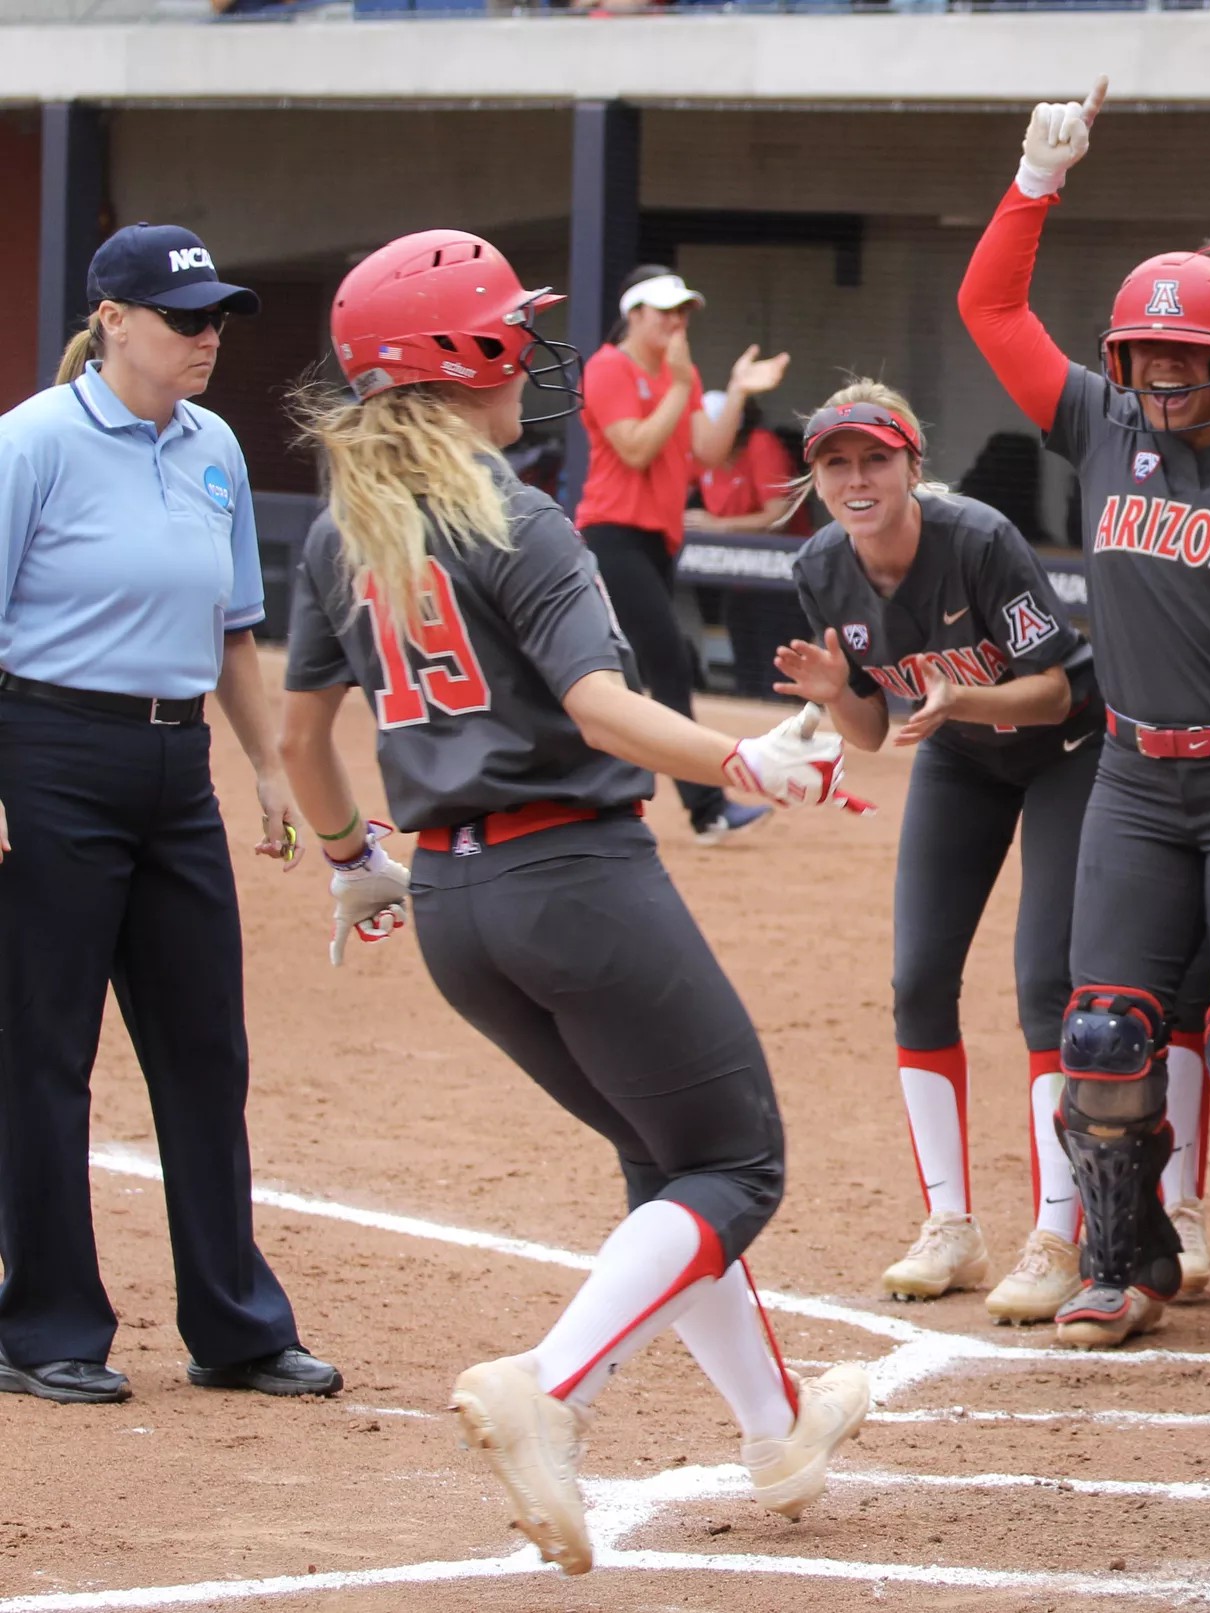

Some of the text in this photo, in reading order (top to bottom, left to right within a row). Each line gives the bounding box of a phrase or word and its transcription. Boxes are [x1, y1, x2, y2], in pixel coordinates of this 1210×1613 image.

[1145, 279, 1185, 317] A
[351, 555, 492, 731] 19
[1002, 591, 1060, 658] A
